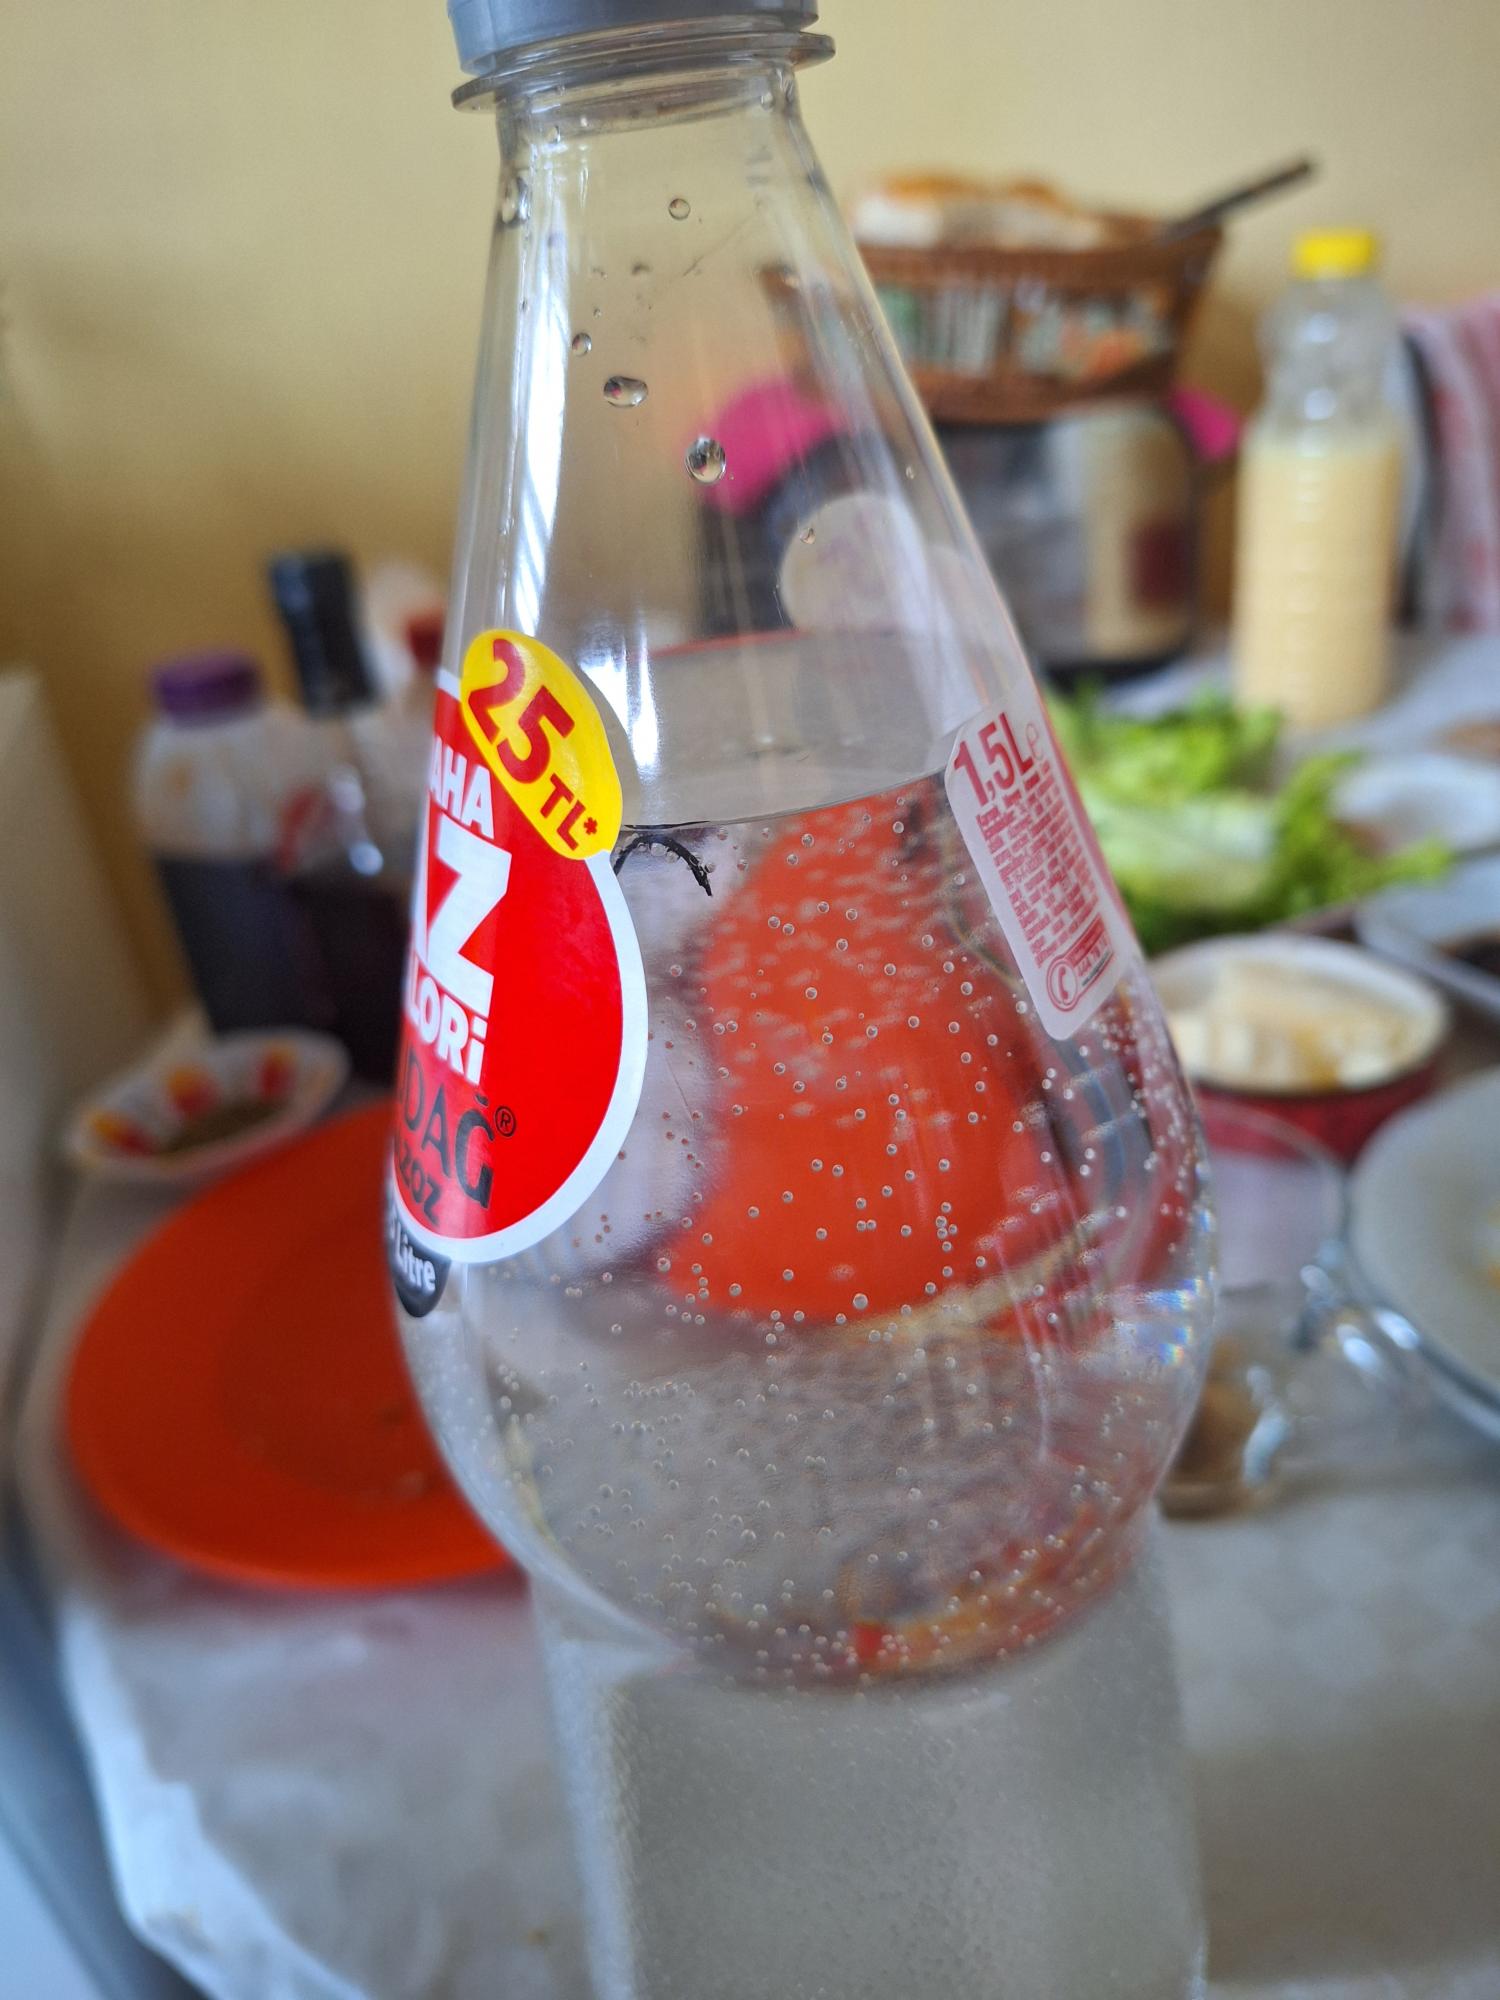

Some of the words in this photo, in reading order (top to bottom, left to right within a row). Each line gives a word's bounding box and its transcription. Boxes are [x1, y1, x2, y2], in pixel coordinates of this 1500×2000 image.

[468, 638, 575, 784] 25
[954, 712, 1034, 807] 1,5L
[427, 736, 495, 840] AHA
[404, 952, 488, 1087] LORi
[400, 1138, 438, 1227] ZOZ
